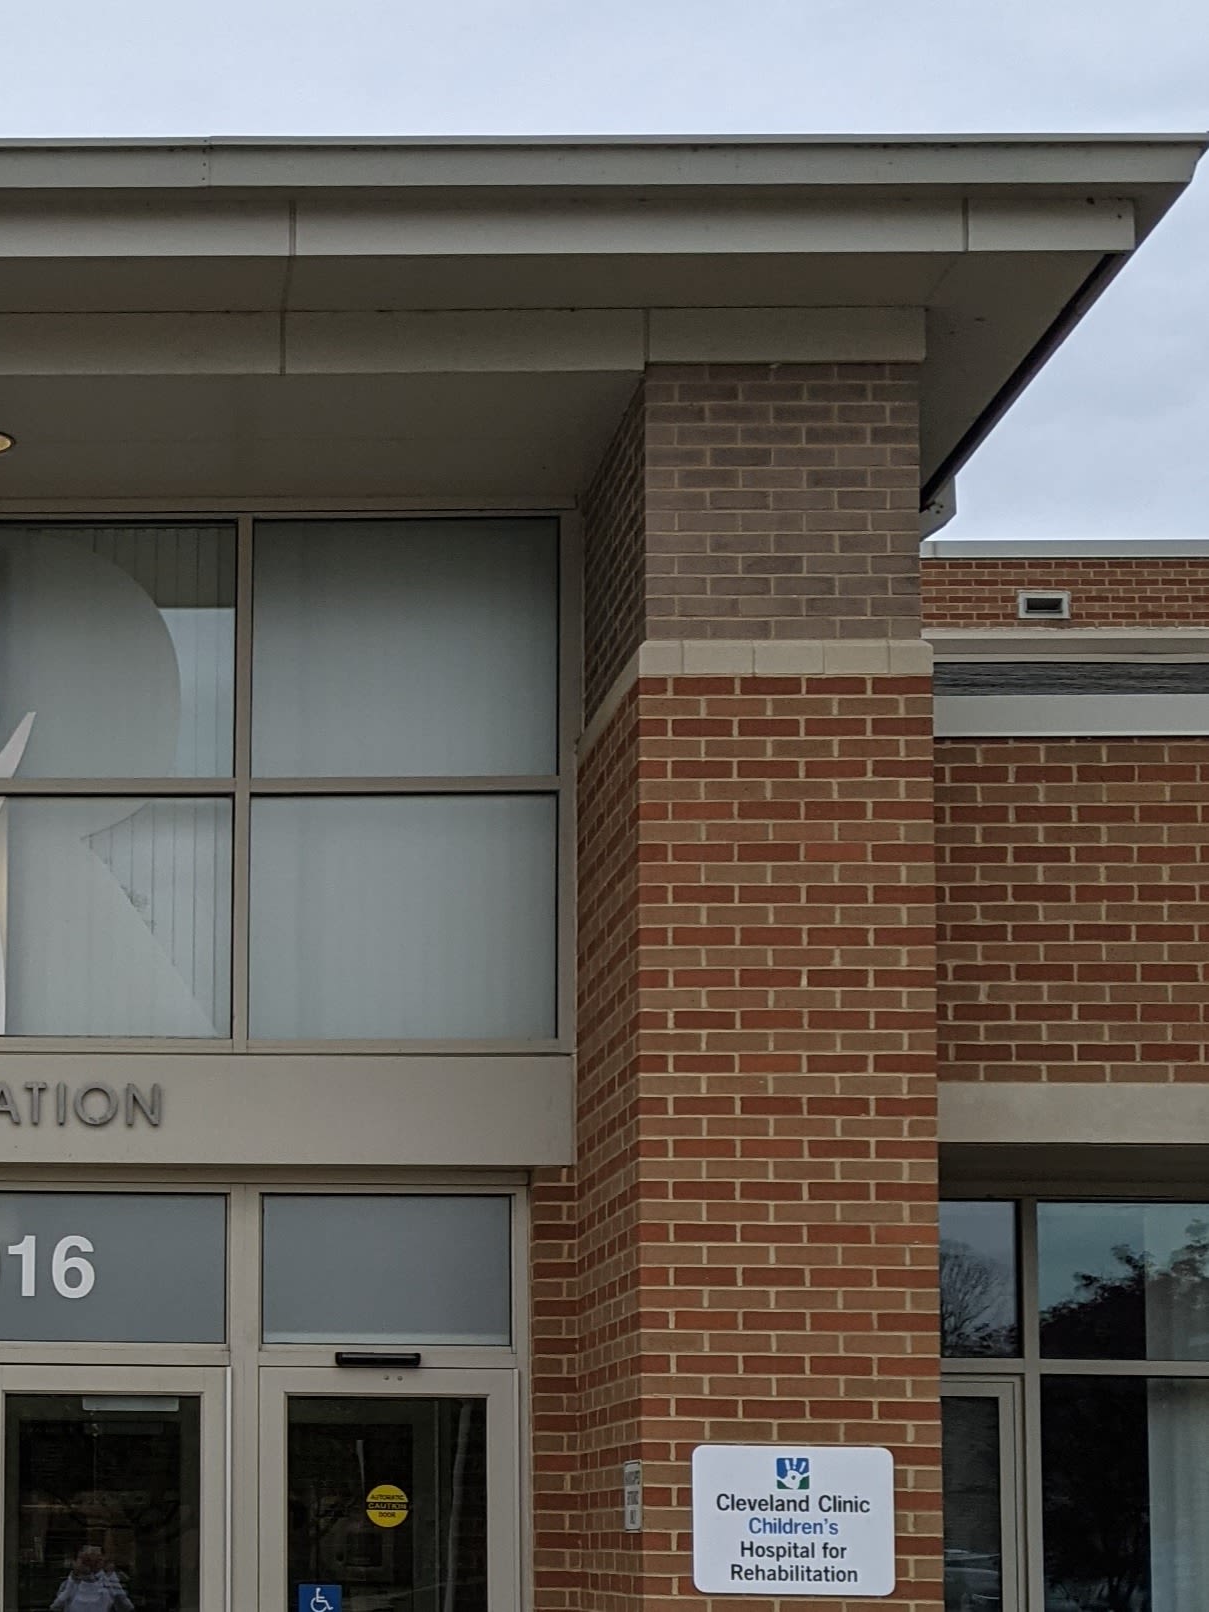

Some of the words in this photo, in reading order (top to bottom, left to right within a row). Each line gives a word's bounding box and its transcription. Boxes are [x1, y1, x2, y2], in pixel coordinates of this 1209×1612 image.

[368, 1502, 407, 1510] CAUTION
[716, 1493, 810, 1513] Cleveland
[818, 1495, 871, 1513] Clinic
[748, 1517, 839, 1535] Children's
[740, 1541, 815, 1561] Hospital
[822, 1542, 847, 1559] for
[730, 1564, 858, 1583] Rehabilitation
